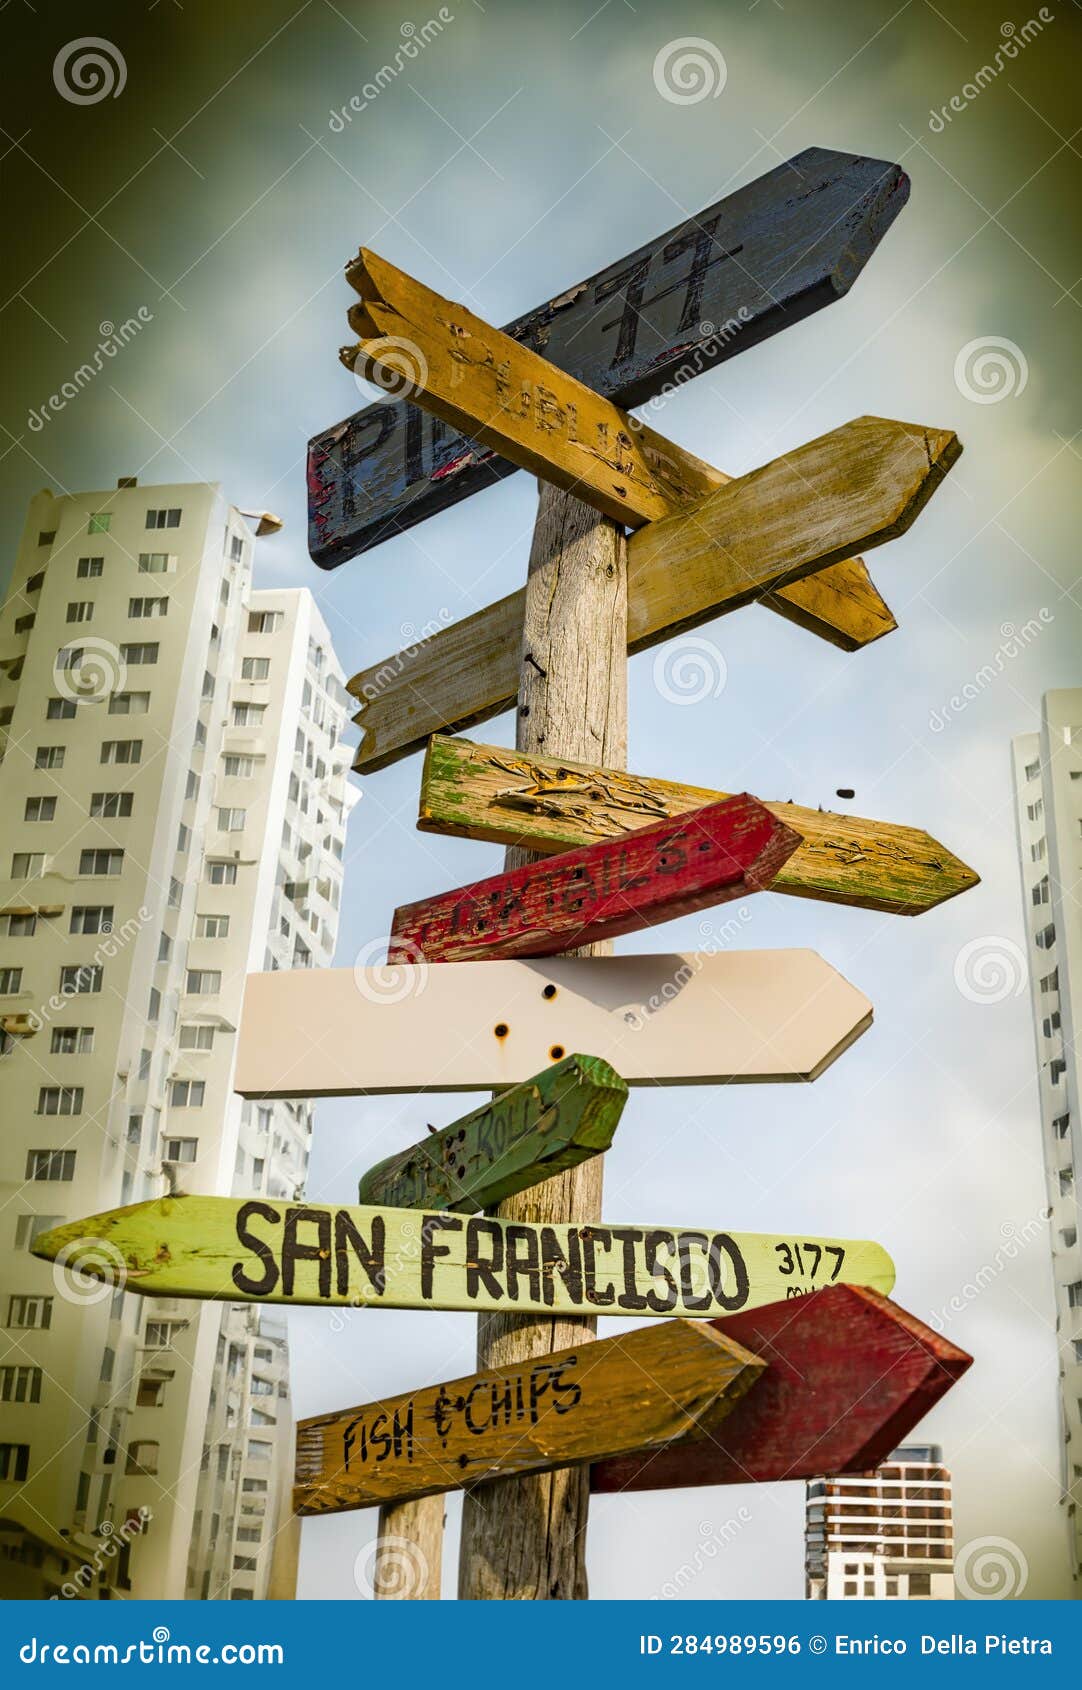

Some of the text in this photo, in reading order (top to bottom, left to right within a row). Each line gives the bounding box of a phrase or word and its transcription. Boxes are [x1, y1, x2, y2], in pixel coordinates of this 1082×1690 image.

[231, 1201, 750, 1312] SAN FRANCISCO
[774, 1242, 846, 1282] 3177
[343, 1400, 414, 1472] FISH
[465, 1355, 582, 1436] CHIPS
